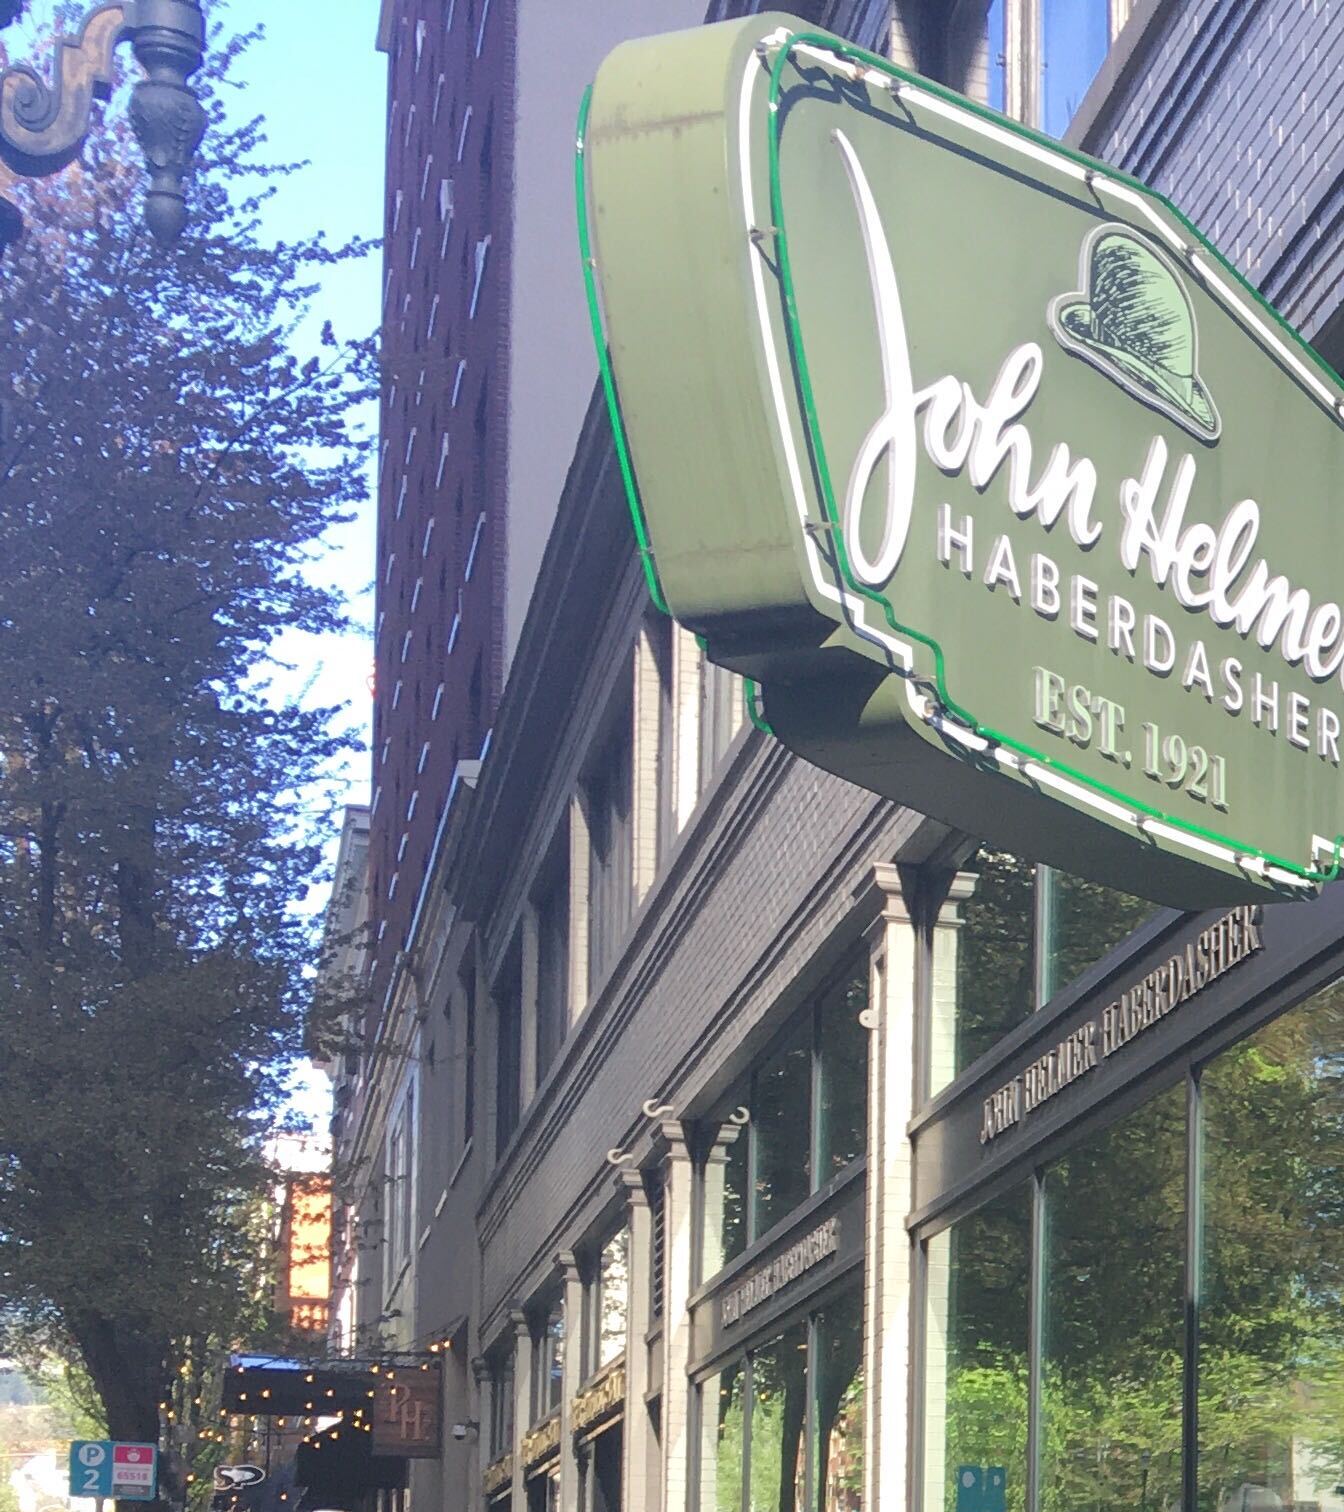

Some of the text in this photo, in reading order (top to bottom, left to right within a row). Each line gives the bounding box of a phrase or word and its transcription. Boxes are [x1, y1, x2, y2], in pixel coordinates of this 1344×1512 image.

[834, 127, 1102, 586] John
[937, 503, 1341, 764] HABERDASHER
[1032, 665, 1230, 810] EST. 1921
[83, 1470, 100, 1489] 2
